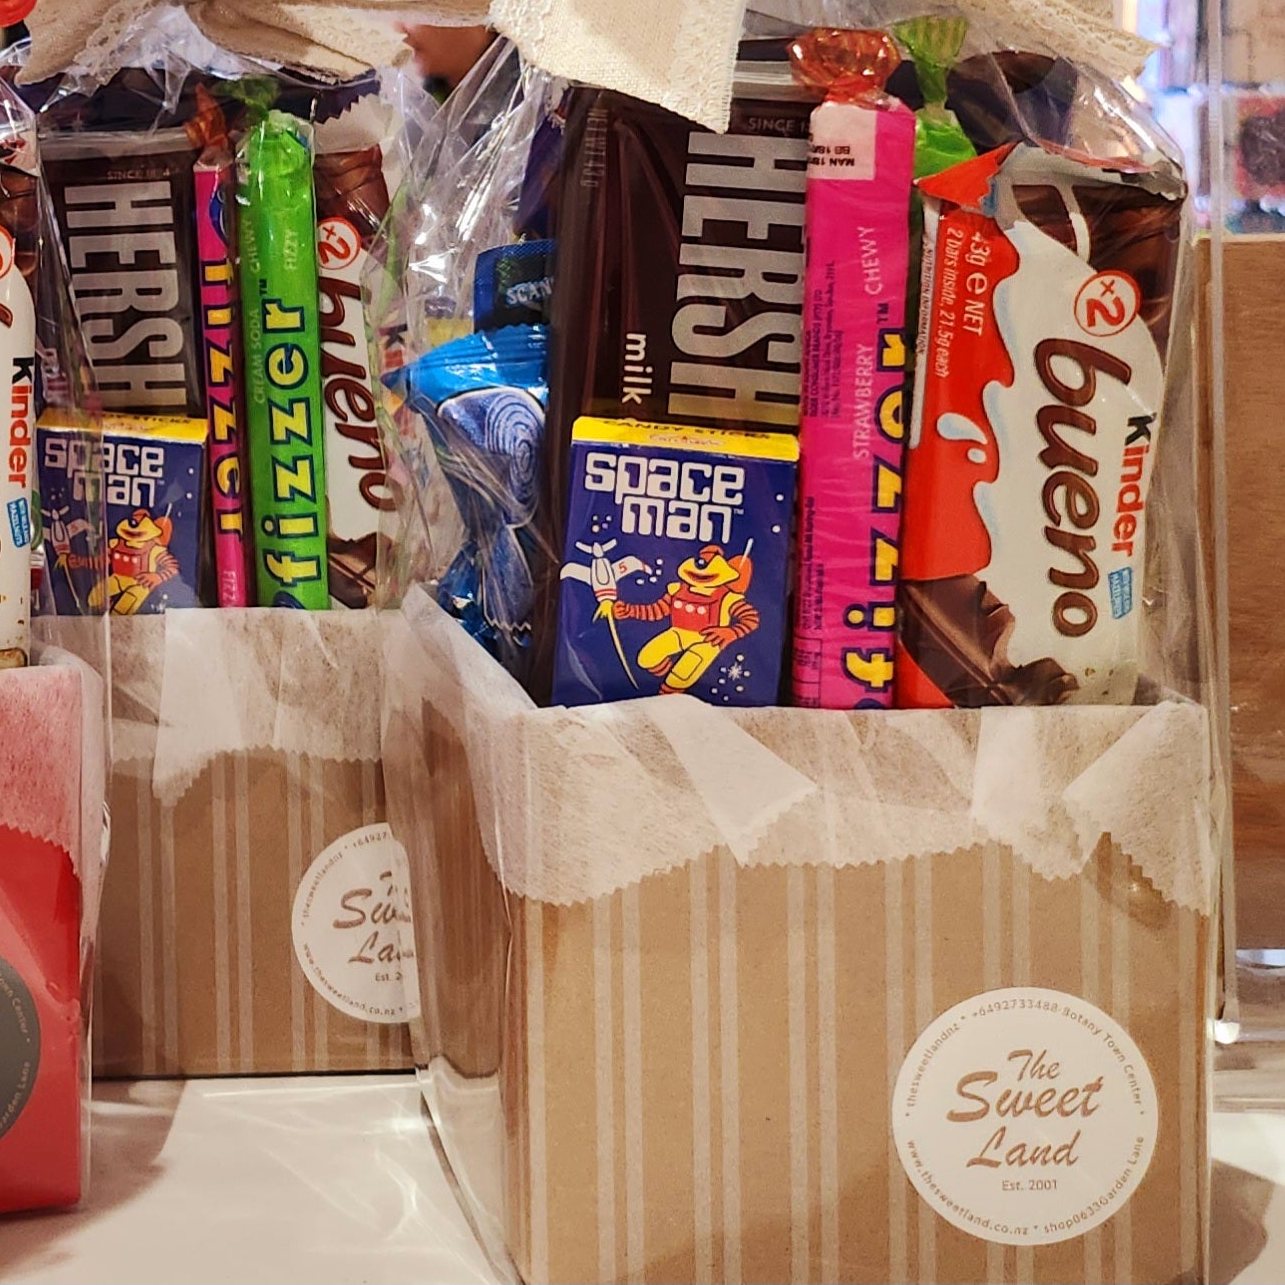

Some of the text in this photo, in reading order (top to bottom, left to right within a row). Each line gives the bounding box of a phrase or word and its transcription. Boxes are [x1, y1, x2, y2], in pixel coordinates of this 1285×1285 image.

[748, 116, 795, 132] SINCE
[829, 158, 855, 166] MAN
[283, 228, 298, 270] FIZZY
[944, 239, 961, 268] bars
[946, 227, 963, 238] 2
[965, 231, 990, 267] 43g
[63, 178, 189, 409] HERSH
[668, 129, 805, 434] HERSH
[249, 308, 262, 349] SODA
[962, 299, 986, 337] NET
[850, 225, 878, 462] STRAWBERRY CHEWY
[934, 347, 949, 378] each
[251, 353, 266, 404] CREAM
[620, 331, 655, 406] milk
[200, 258, 245, 537] fizzer
[318, 276, 402, 511] bueno
[8, 357, 37, 489] Kinder
[261, 297, 320, 588] fizzer
[44, 436, 166, 480] space
[82, 475, 157, 508] man
[584, 451, 746, 510] space
[1033, 336, 1134, 640] bueno
[1111, 411, 1158, 558] Kinder
[621, 503, 733, 544] man
[1007, 1048, 1061, 1082] The
[1103, 1033, 1127, 1064] Town
[1123, 1064, 1142, 1105] Center
[946, 1070, 1105, 1123] Sweet
[965, 1125, 1082, 1169] Land
[1127, 1135, 1144, 1167] Lane
[1001, 1179, 1057, 1191] Est. 2001
